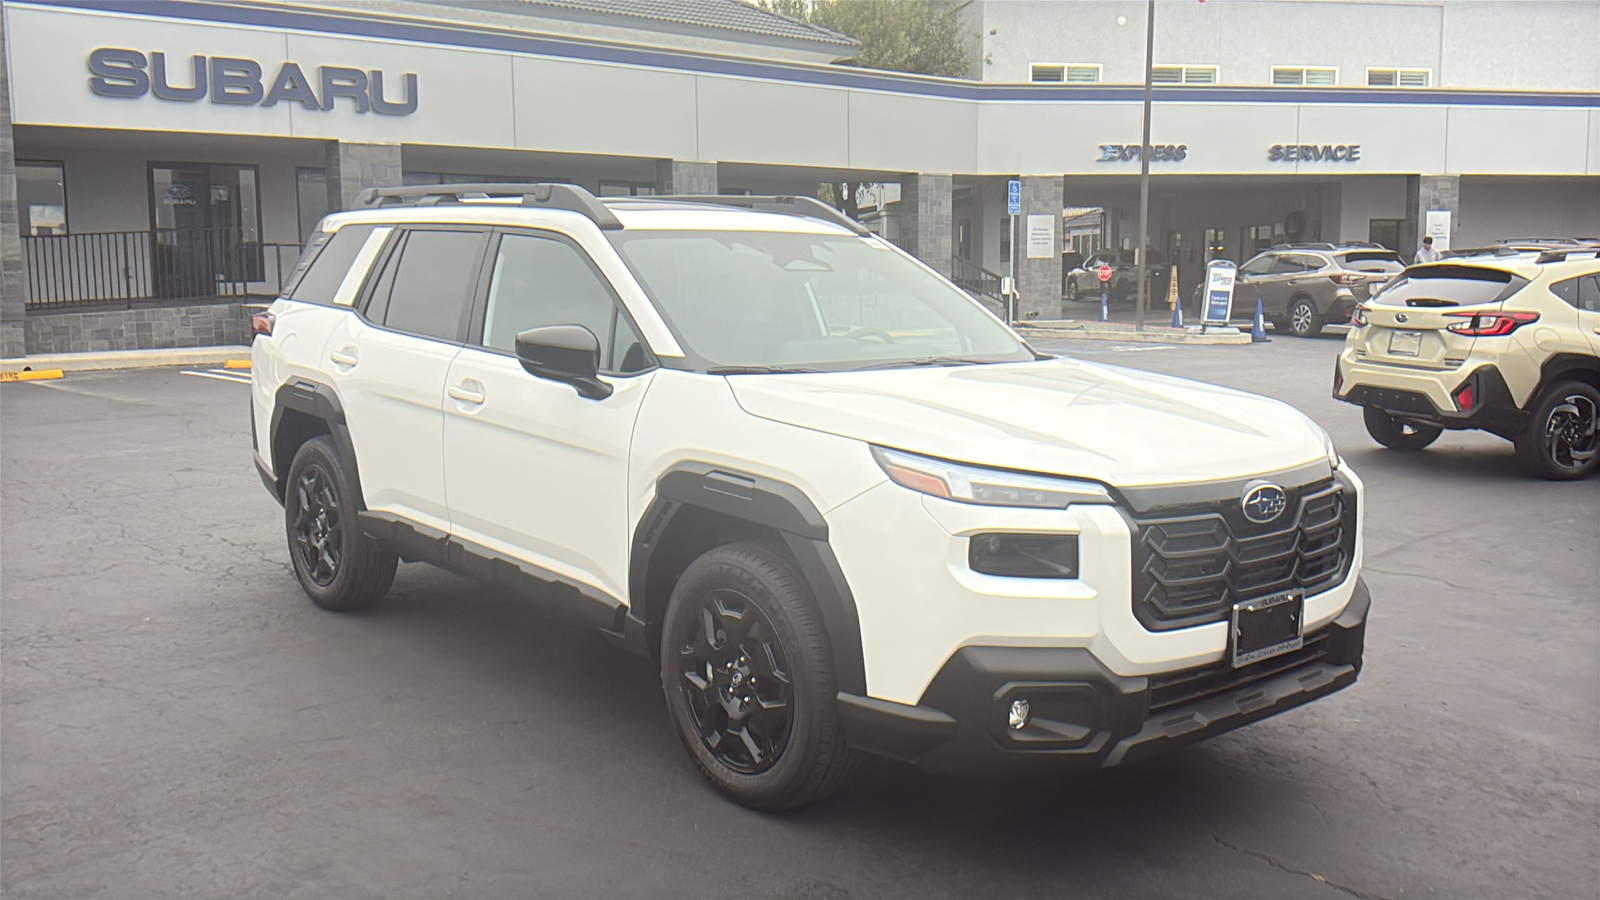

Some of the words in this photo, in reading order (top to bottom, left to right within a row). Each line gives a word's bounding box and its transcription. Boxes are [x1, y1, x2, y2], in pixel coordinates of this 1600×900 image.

[87, 47, 418, 116] SUBARU
[1095, 144, 1188, 162] EXPESS
[1267, 144, 1361, 161] SERVICE
